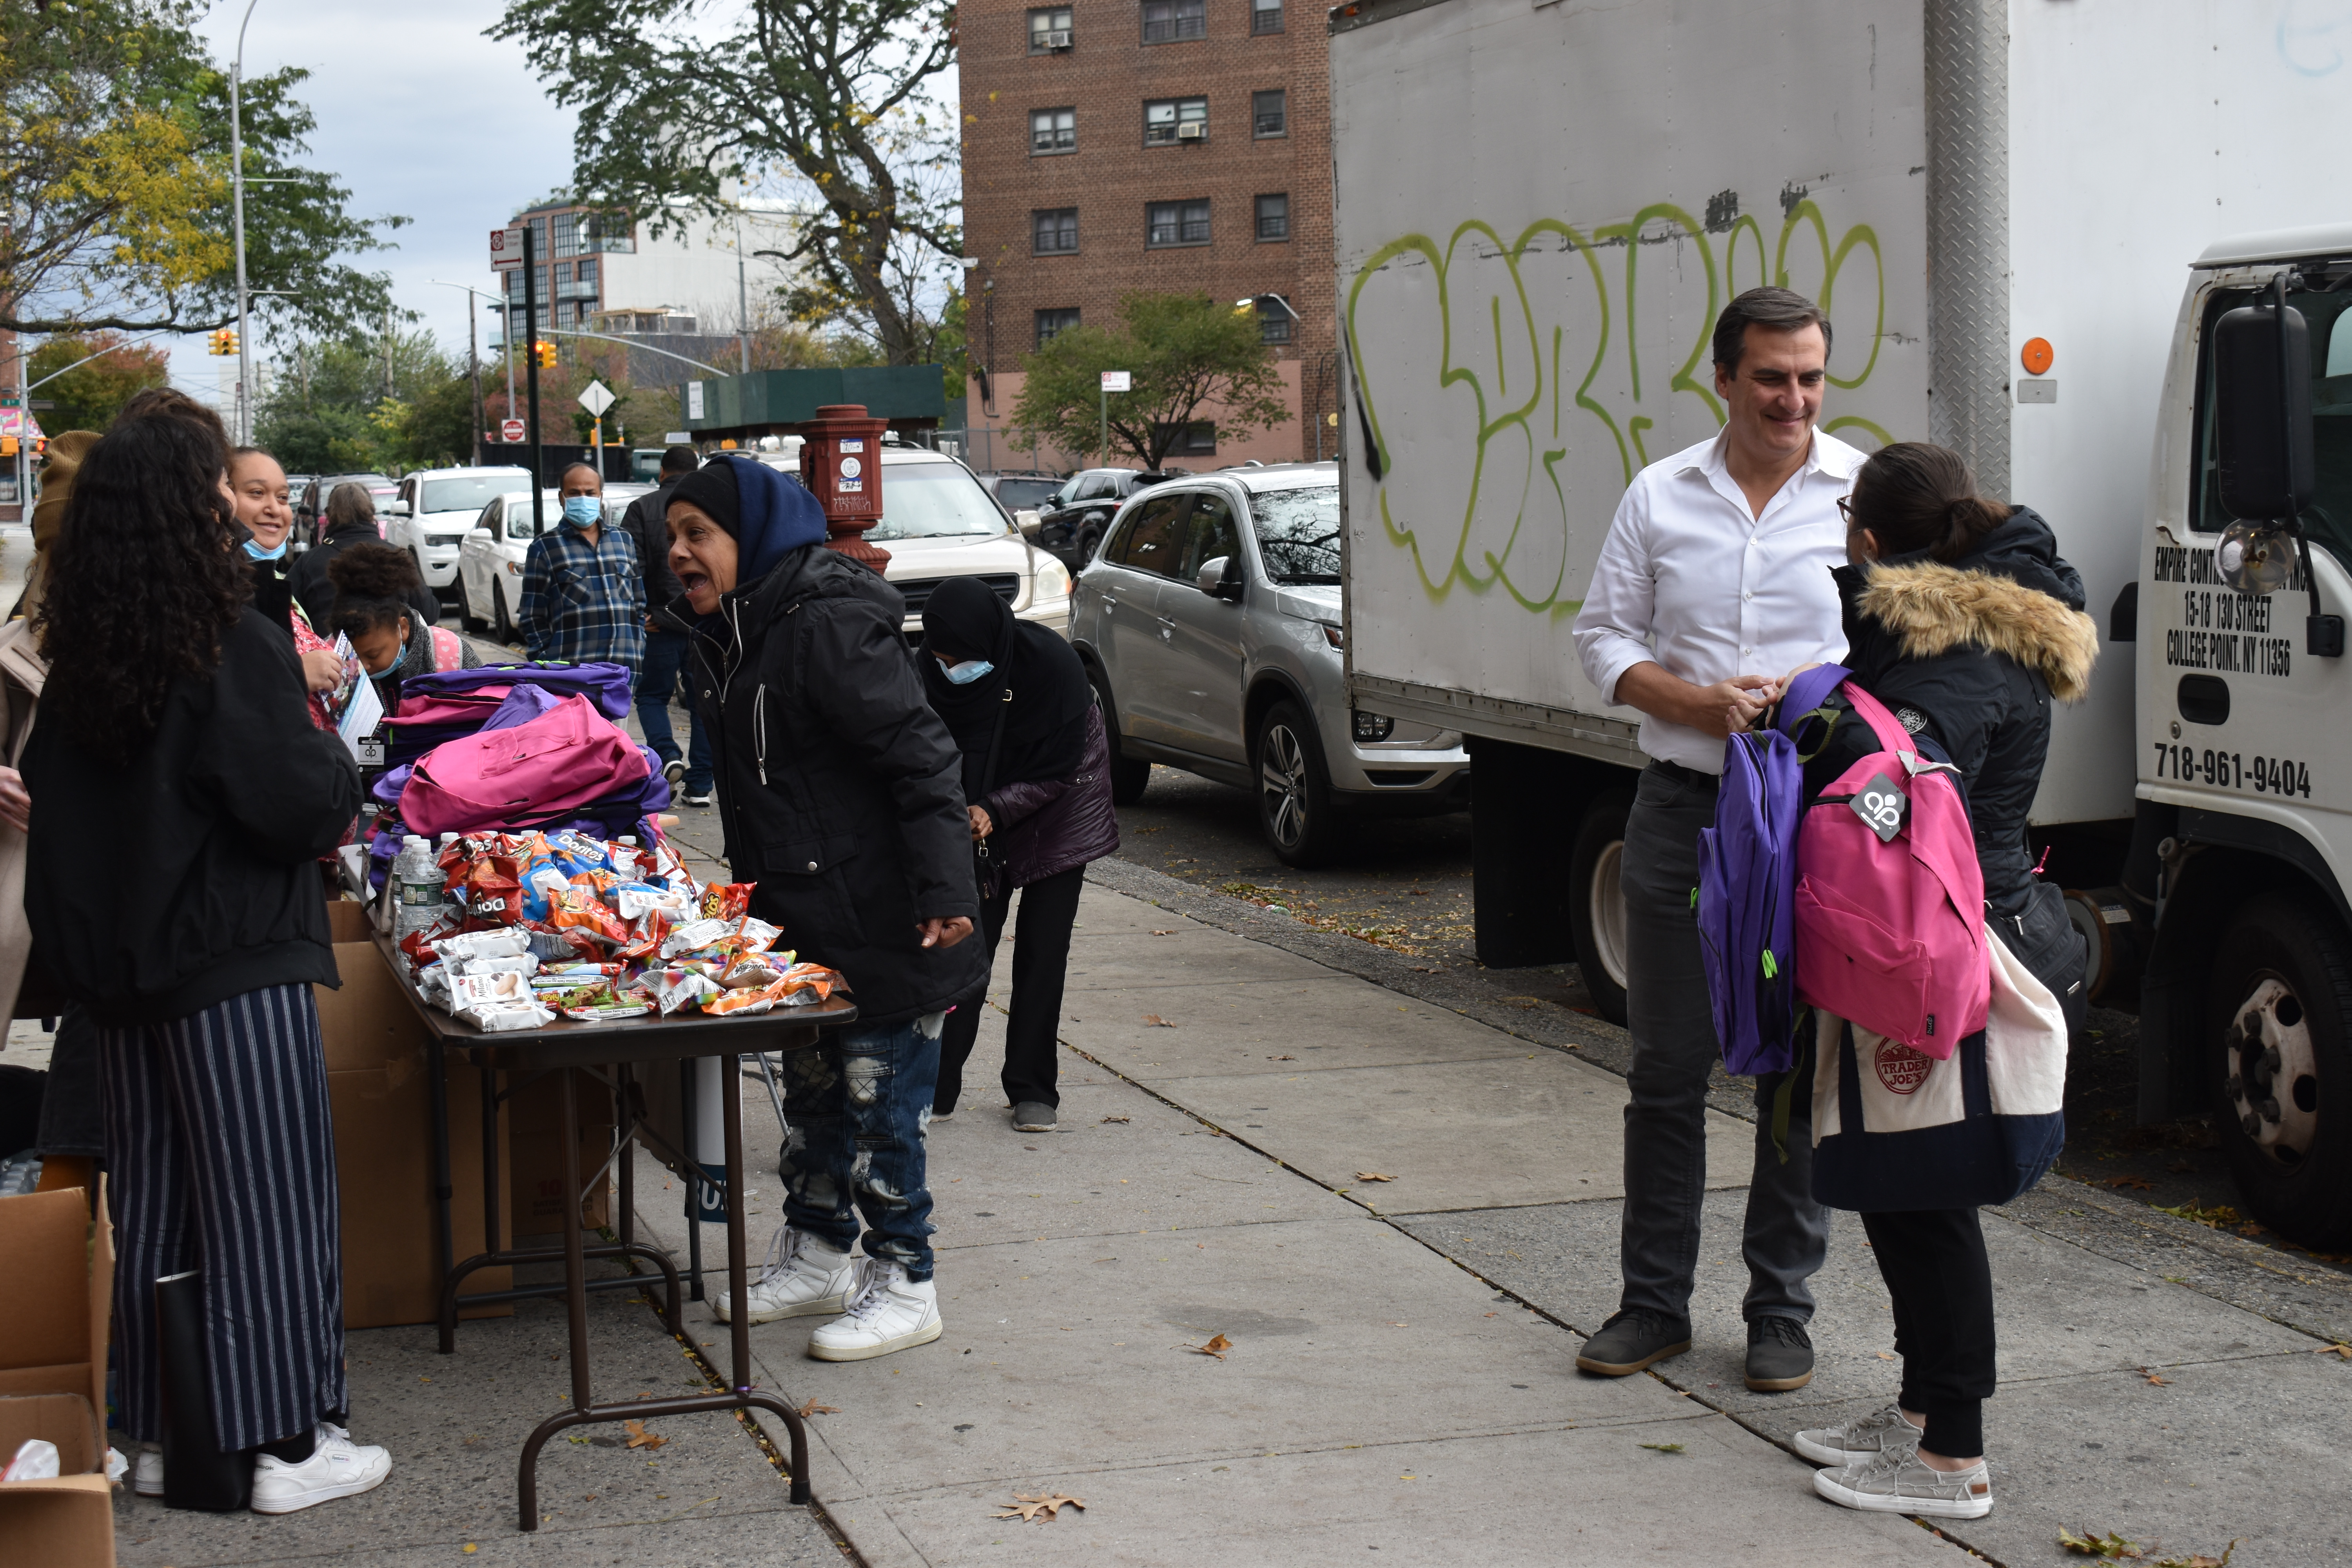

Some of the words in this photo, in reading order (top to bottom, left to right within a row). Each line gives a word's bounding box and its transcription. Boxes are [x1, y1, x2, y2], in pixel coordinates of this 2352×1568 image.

[2155, 546, 2187, 583] EMPIRE
[2184, 590, 2210, 628] 15-18
[2216, 593, 2233, 630] 130
[2236, 594, 2272, 633] STREET
[338, 633, 348, 659] NARIS
[2167, 629, 2207, 668] COLLEGE
[2243, 636, 2256, 673] NY
[2259, 637, 2290, 677] 11356
[2154, 742, 2311, 799] 718-961-9404
[466, 839, 492, 851] ritos
[558, 835, 605, 862] Doritos
[704, 895, 720, 918] etos
[477, 976, 488, 999] Milano
[1881, 1059, 1928, 1074] TRADER
[1889, 1072, 1922, 1085] JOE'S
[533, 1205, 592, 1216] GUARAED
